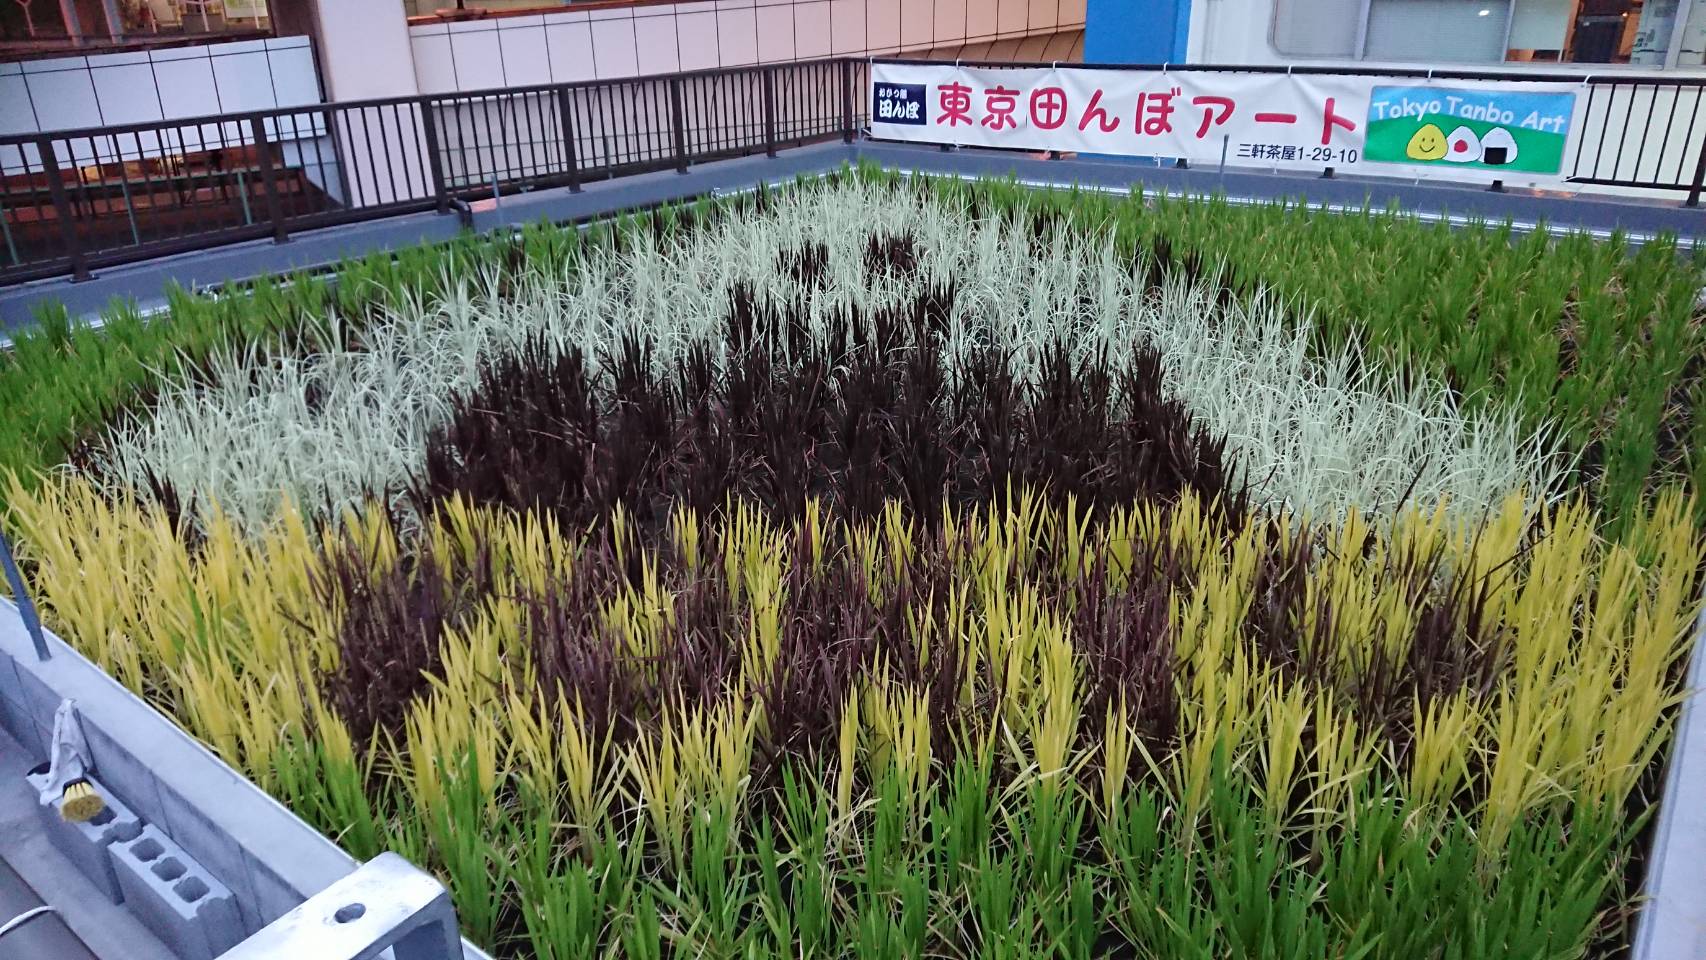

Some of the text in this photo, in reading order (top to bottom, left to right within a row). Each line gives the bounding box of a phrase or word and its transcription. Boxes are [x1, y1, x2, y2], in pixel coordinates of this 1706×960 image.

[878, 99, 920, 119] 田んぼ
[936, 81, 1357, 145] 東京田んぼアート
[1373, 96, 1565, 133] Tokyo Tanbo Art
[1236, 143, 1358, 163] 三軒茶屋1-29-10
